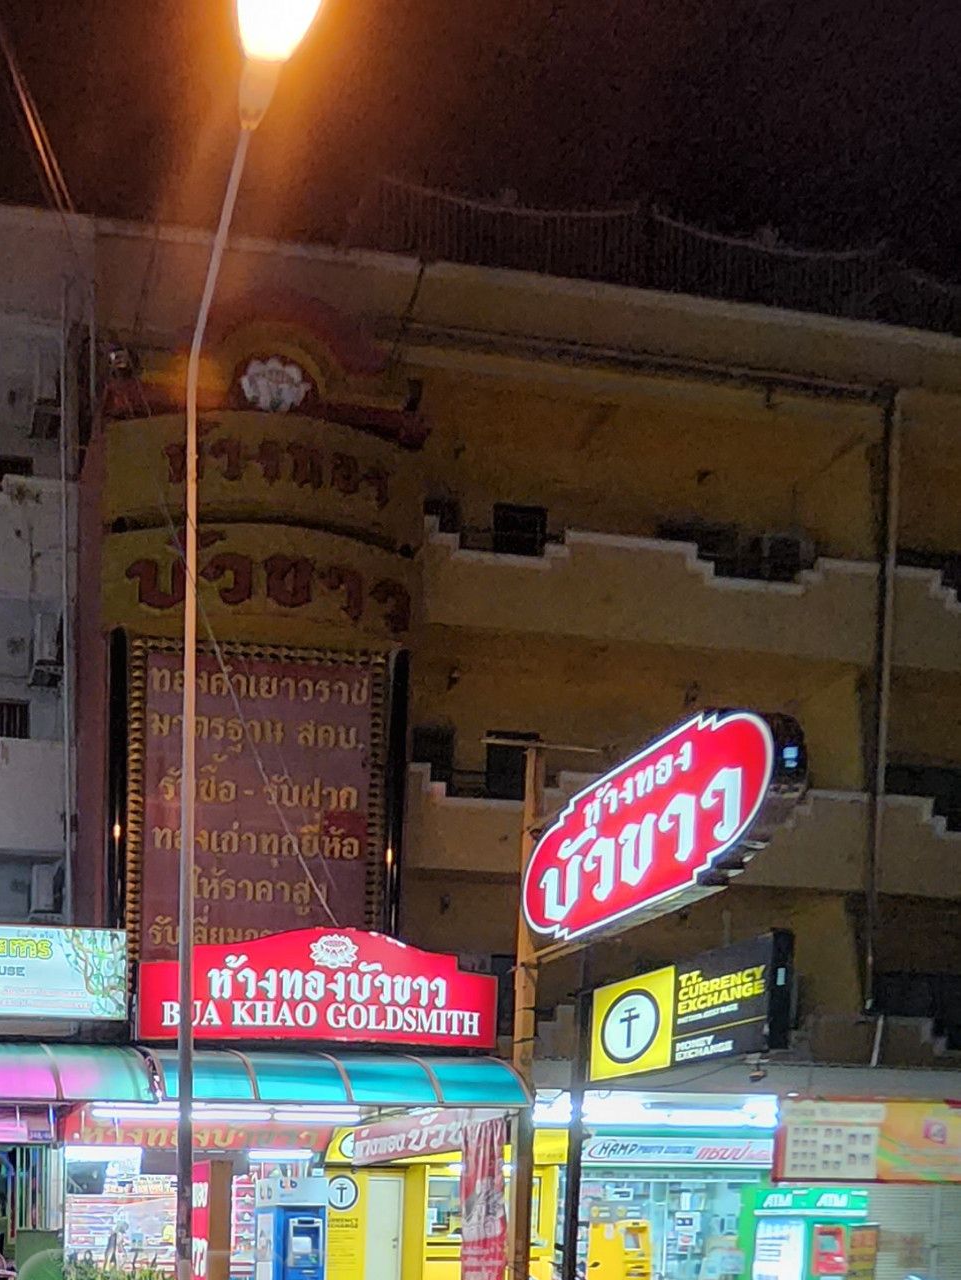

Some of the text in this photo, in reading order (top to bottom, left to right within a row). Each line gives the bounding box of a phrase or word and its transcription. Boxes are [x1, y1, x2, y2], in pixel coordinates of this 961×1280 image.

[583, 741, 693, 827] ห้างทอง
[539, 766, 742, 921] บัวขาว
[208, 953, 447, 1008] ห้างทองบัวขาว
[677, 979, 766, 1015] EXCHANGE
[678, 965, 766, 1001] CURRENCY
[232, 1001, 317, 1027] KHAO
[326, 1003, 480, 1037] GOLDSMITH
